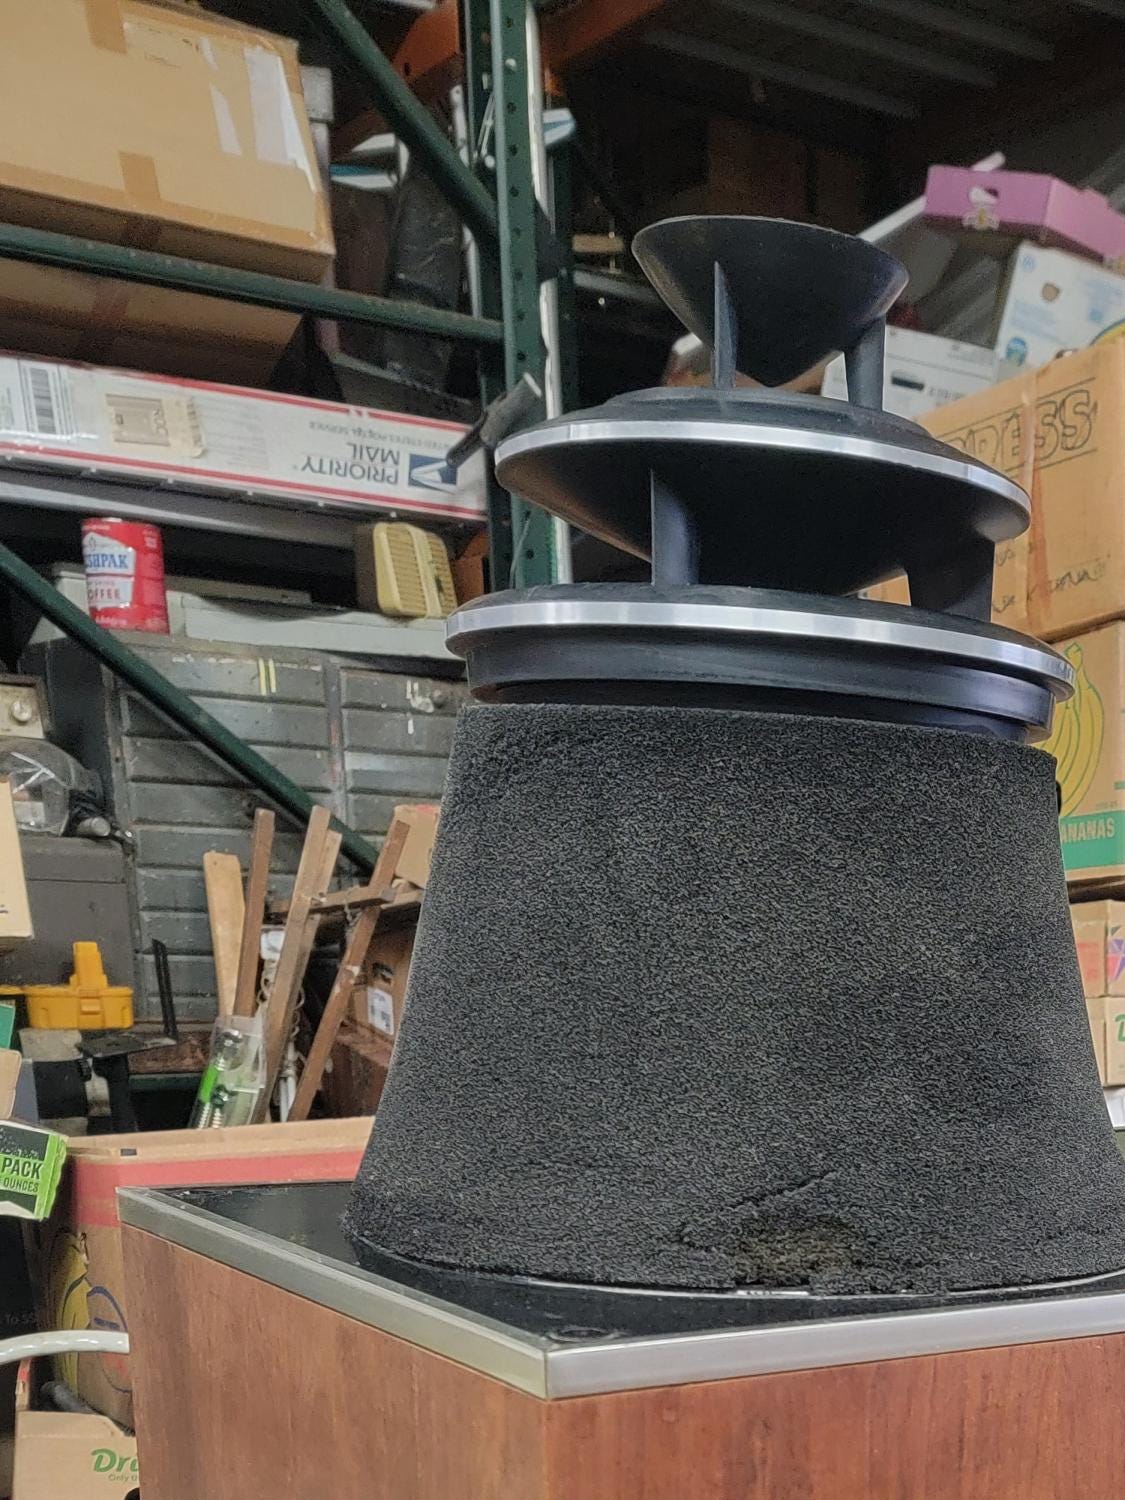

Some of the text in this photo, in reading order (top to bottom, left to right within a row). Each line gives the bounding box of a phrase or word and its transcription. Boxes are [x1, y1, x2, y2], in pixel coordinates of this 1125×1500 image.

[347, 442, 400, 466] MAIL
[301, 455, 399, 485] PRIORITY
[1, 1157, 43, 1180] PACK
[3, 1177, 40, 1193] OUNCES
